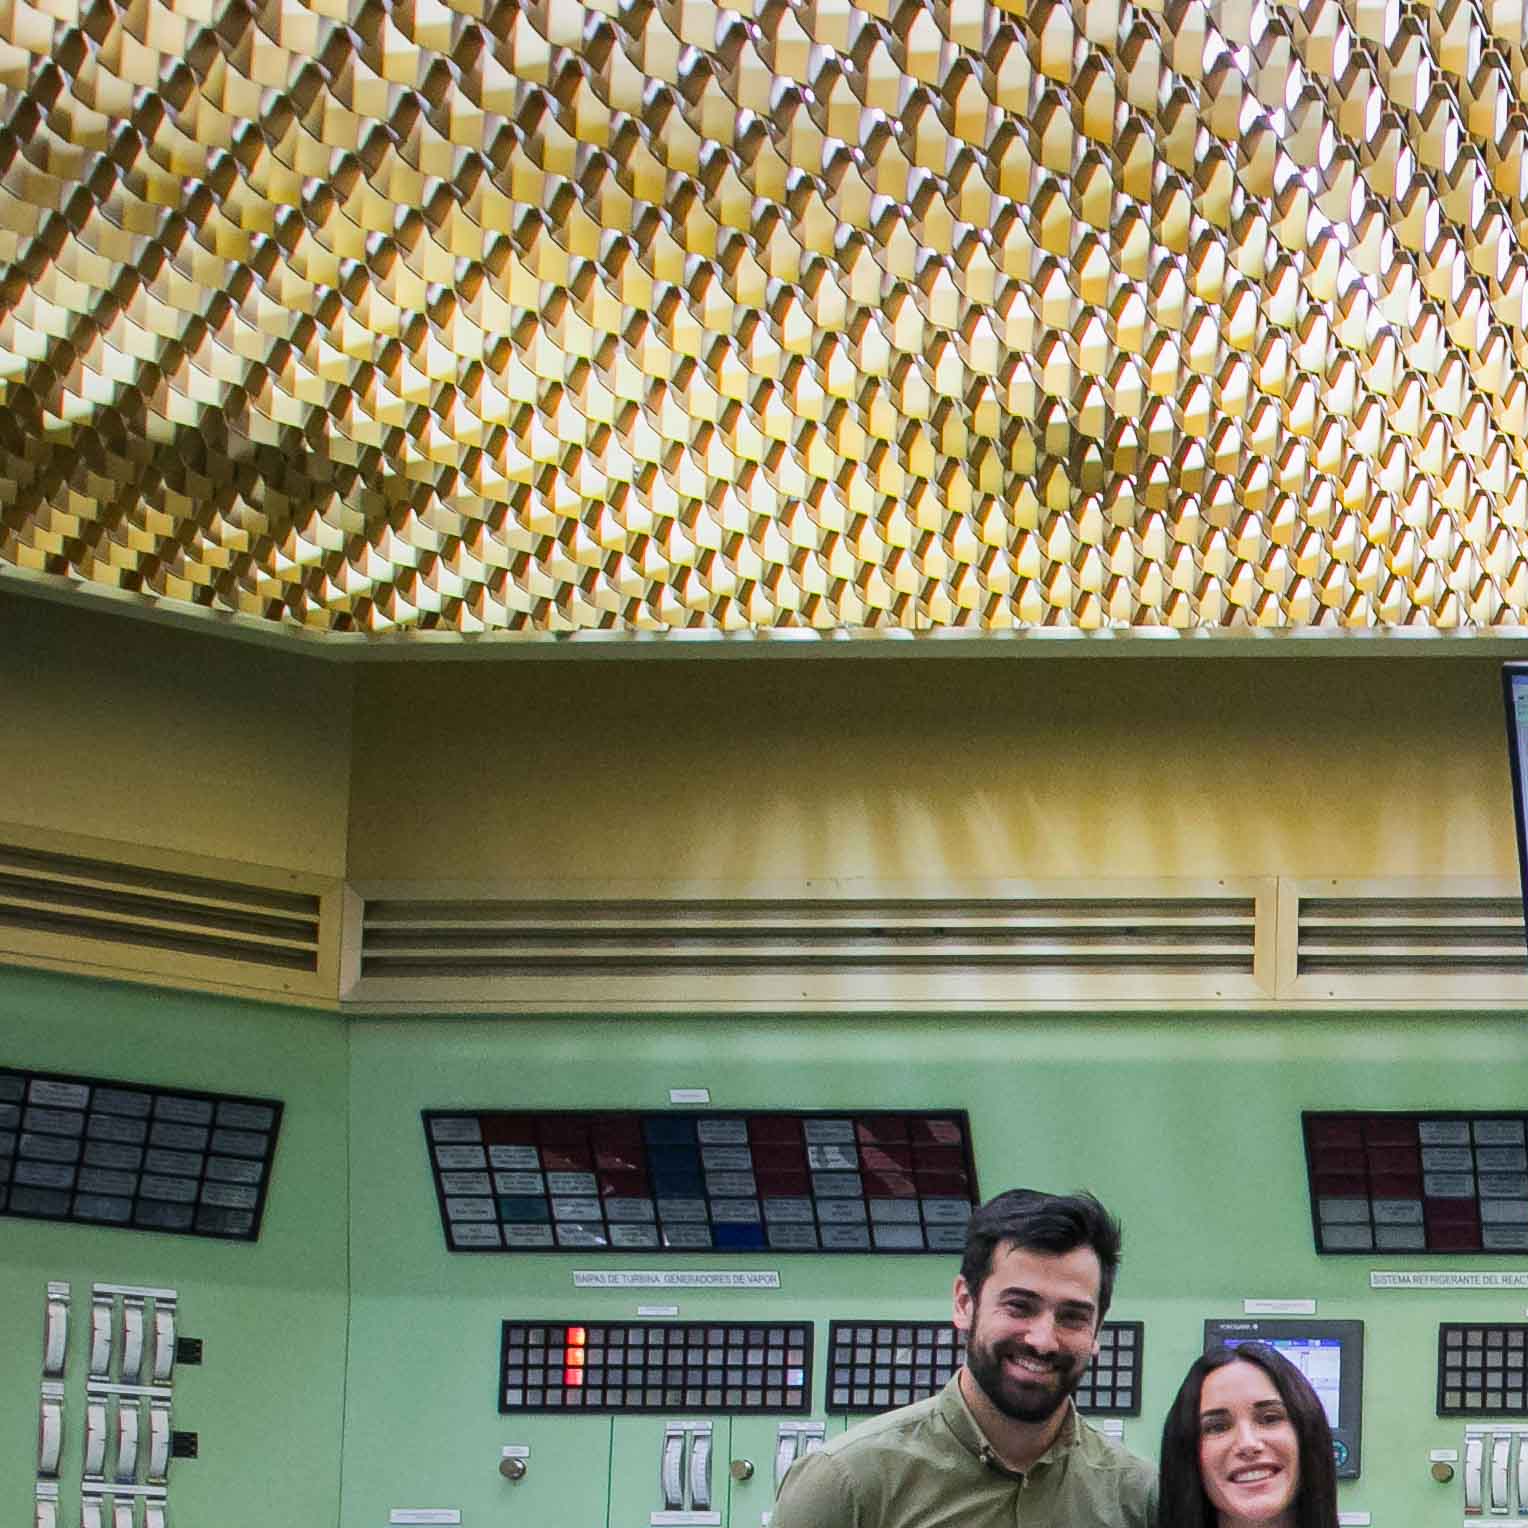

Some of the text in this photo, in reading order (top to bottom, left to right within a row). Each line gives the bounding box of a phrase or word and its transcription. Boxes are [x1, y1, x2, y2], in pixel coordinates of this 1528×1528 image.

[747, 1274, 778, 1284] VAPOR
[1373, 1275, 1411, 1285] SISTEMA
[1412, 1275, 1481, 1285] REFRIGERANTE
[1482, 1275, 1499, 1285] DEL
